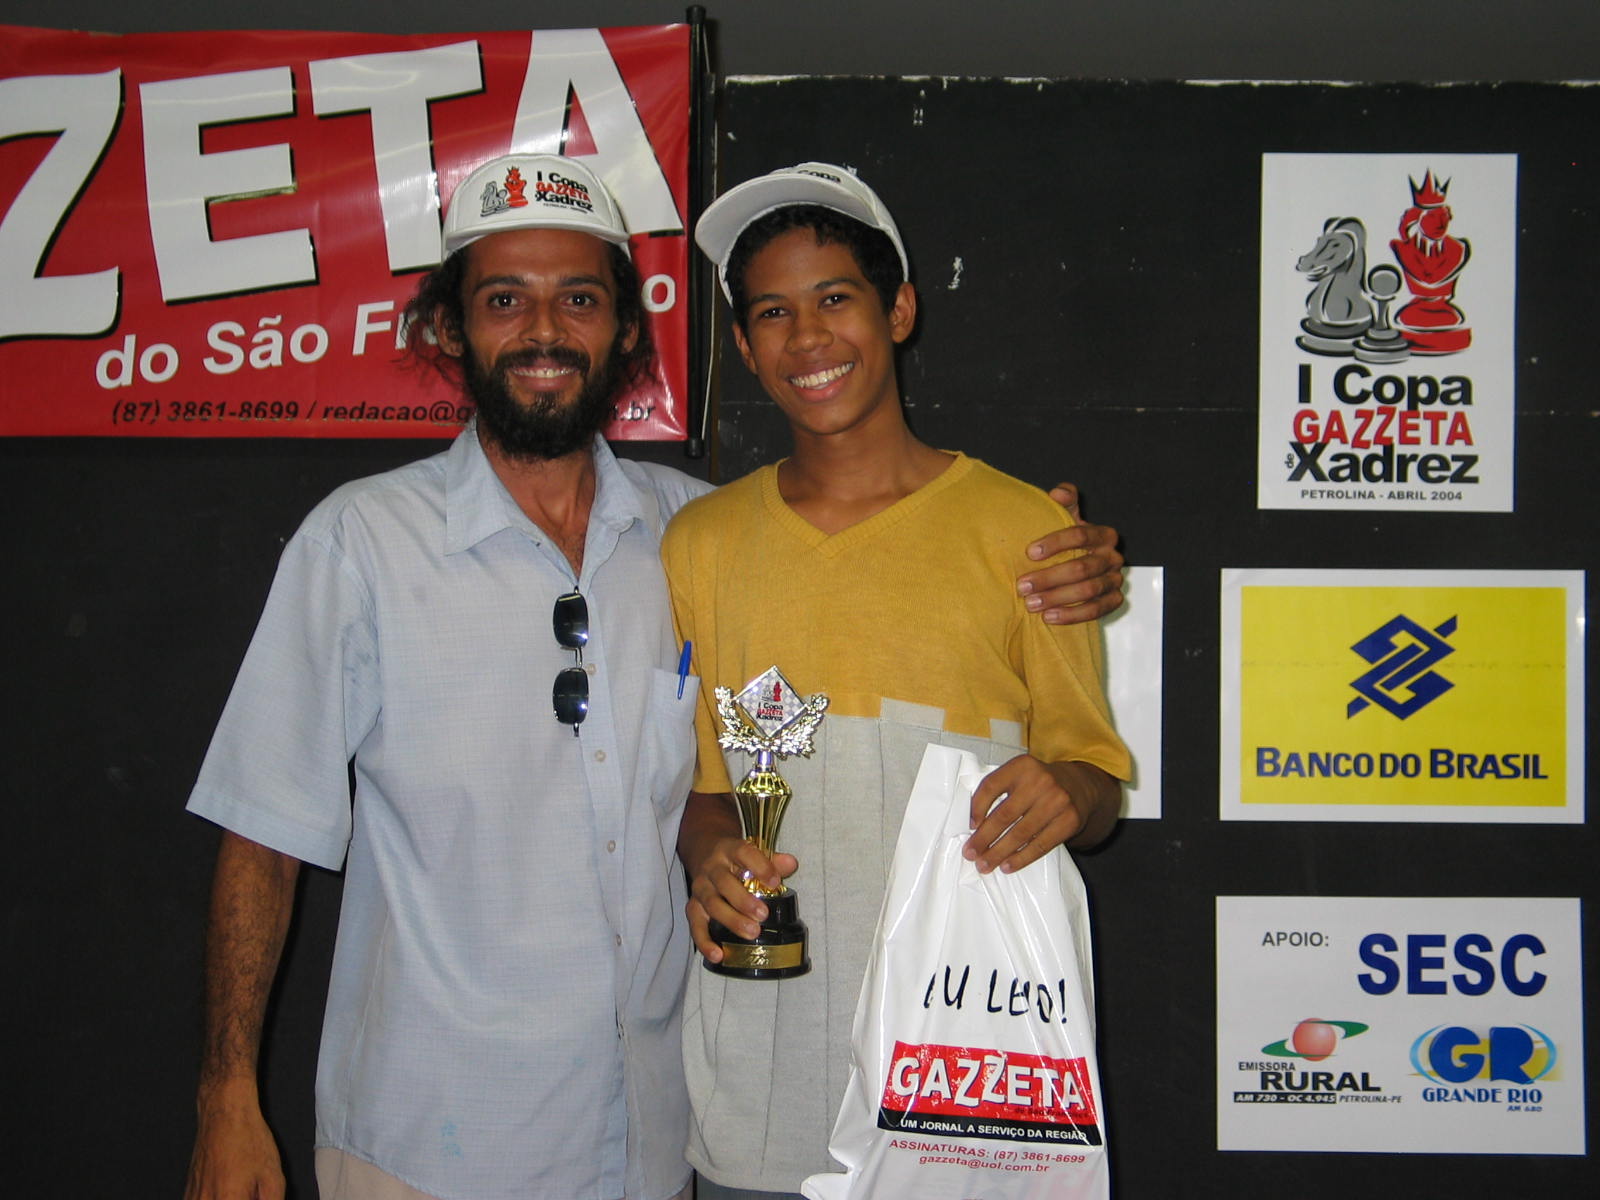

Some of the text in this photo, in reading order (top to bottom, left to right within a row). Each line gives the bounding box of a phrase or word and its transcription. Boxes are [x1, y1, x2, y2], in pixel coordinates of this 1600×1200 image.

[95, 334, 180, 390] do
[203, 315, 330, 375] São
[1298, 363, 1474, 411] I Copa
[112, 400, 161, 424] (87)
[167, 401, 299, 422] 3861-8699
[1292, 405, 1474, 450] GAZZETA
[1287, 441, 1480, 484] Xadrez
[1301, 489, 1376, 500] PETROLINA
[1387, 489, 1428, 501] ABRIL
[1431, 491, 1463, 501] 2004
[1256, 747, 1549, 780] BANCO DO BRASIL
[1261, 931, 1330, 948] APOIO:
[1357, 932, 1548, 997] SESC
[1238, 1061, 1296, 1071] EMISSORA
[1428, 1025, 1535, 1085] GR
[891, 1054, 1088, 1111] GAZZETA
[1259, 1071, 1382, 1092] RURAL
[1235, 1093, 1255, 1103] AM
[1256, 1094, 1277, 1103] 730
[1287, 1094, 1303, 1103] OC
[1422, 1087, 1543, 1104] GRANDE RIO
[900, 1119, 918, 1130] UM
[919, 1120, 965, 1134] JORNAL
[968, 1123, 976, 1133] A
[978, 1125, 1025, 1138] SERVIÇO
[1027, 1128, 1043, 1138] DA
[888, 1138, 1086, 1164] ASSINATURAS: (87) 3861-8699
[918, 1155, 1051, 1173] gazzeta@uol.com.br
